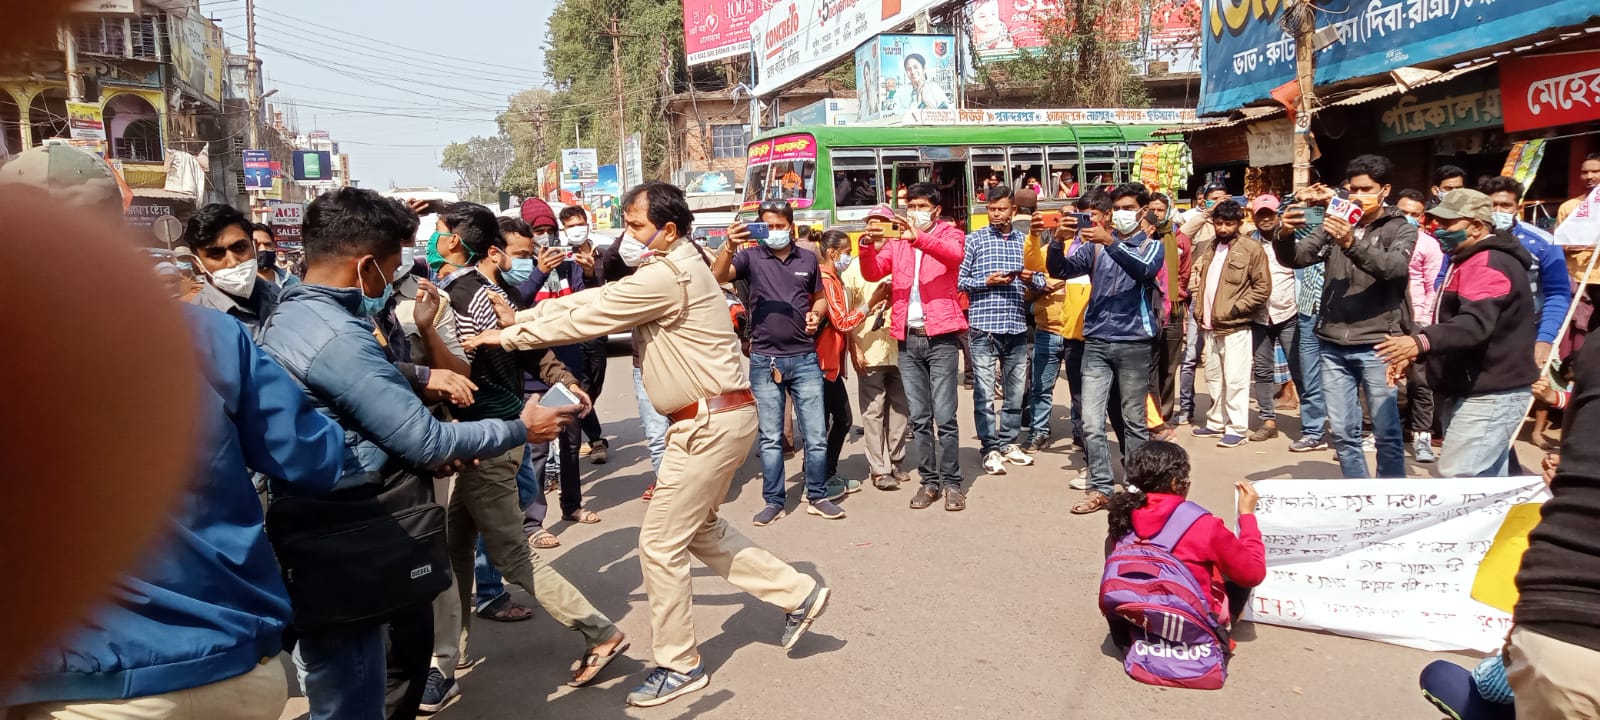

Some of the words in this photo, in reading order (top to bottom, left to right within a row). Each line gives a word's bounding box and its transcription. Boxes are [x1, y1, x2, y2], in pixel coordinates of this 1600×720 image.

[1233, 48, 1258, 75] ভাত
[275, 207, 300, 218] ACE
[276, 228, 301, 236] SALES
